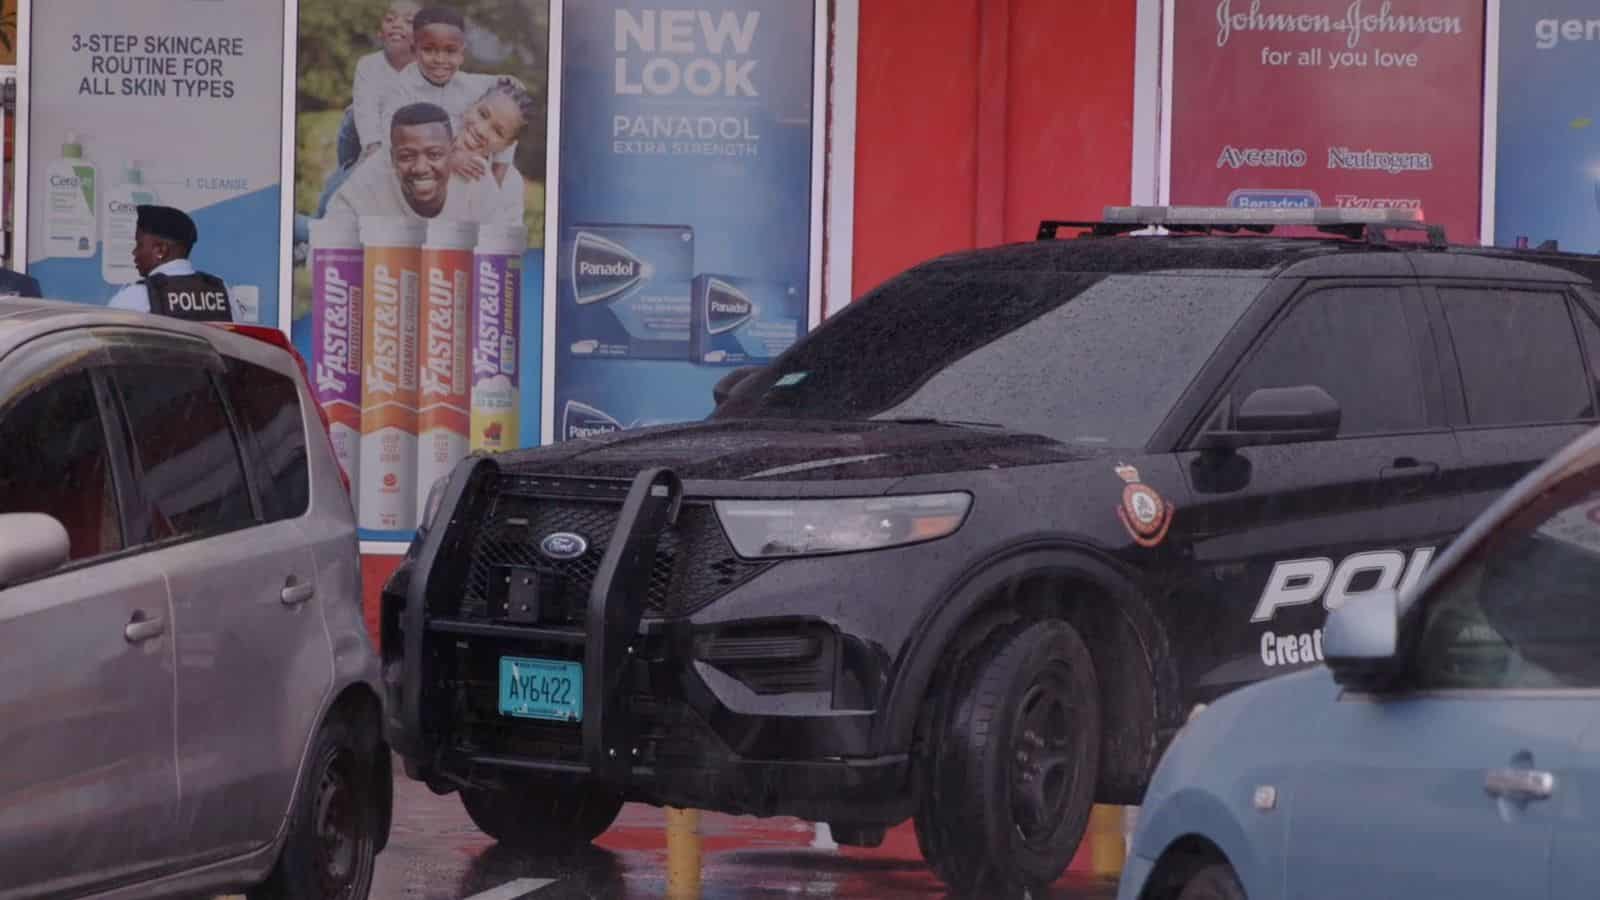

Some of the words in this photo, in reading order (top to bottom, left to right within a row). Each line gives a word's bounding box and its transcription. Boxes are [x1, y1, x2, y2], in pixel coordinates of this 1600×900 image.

[614, 9, 761, 54] NEW
[72, 34, 139, 54] 3-STEP
[144, 36, 244, 56] SKINCARE
[92, 56, 177, 76] ROUTINE
[183, 58, 223, 77] FOR
[1261, 48, 1291, 66] for
[1298, 48, 1321, 66] all
[1329, 52, 1367, 69] you
[1375, 49, 1418, 67] love
[615, 58, 760, 96] LOOK
[79, 78, 115, 96] ALL
[121, 78, 166, 97] SKIN
[172, 79, 235, 98] TYPES
[613, 115, 760, 140] PANADOL
[613, 140, 667, 154] EXTRA
[672, 141, 758, 156] STRENGTH
[1216, 145, 1307, 168] Aveeno
[1327, 146, 1433, 173] Neutrogena
[579, 261, 633, 276] Panadol
[167, 292, 226, 311] POLICE
[711, 301, 748, 314] Panadol
[508, 674, 572, 705] AY6422
